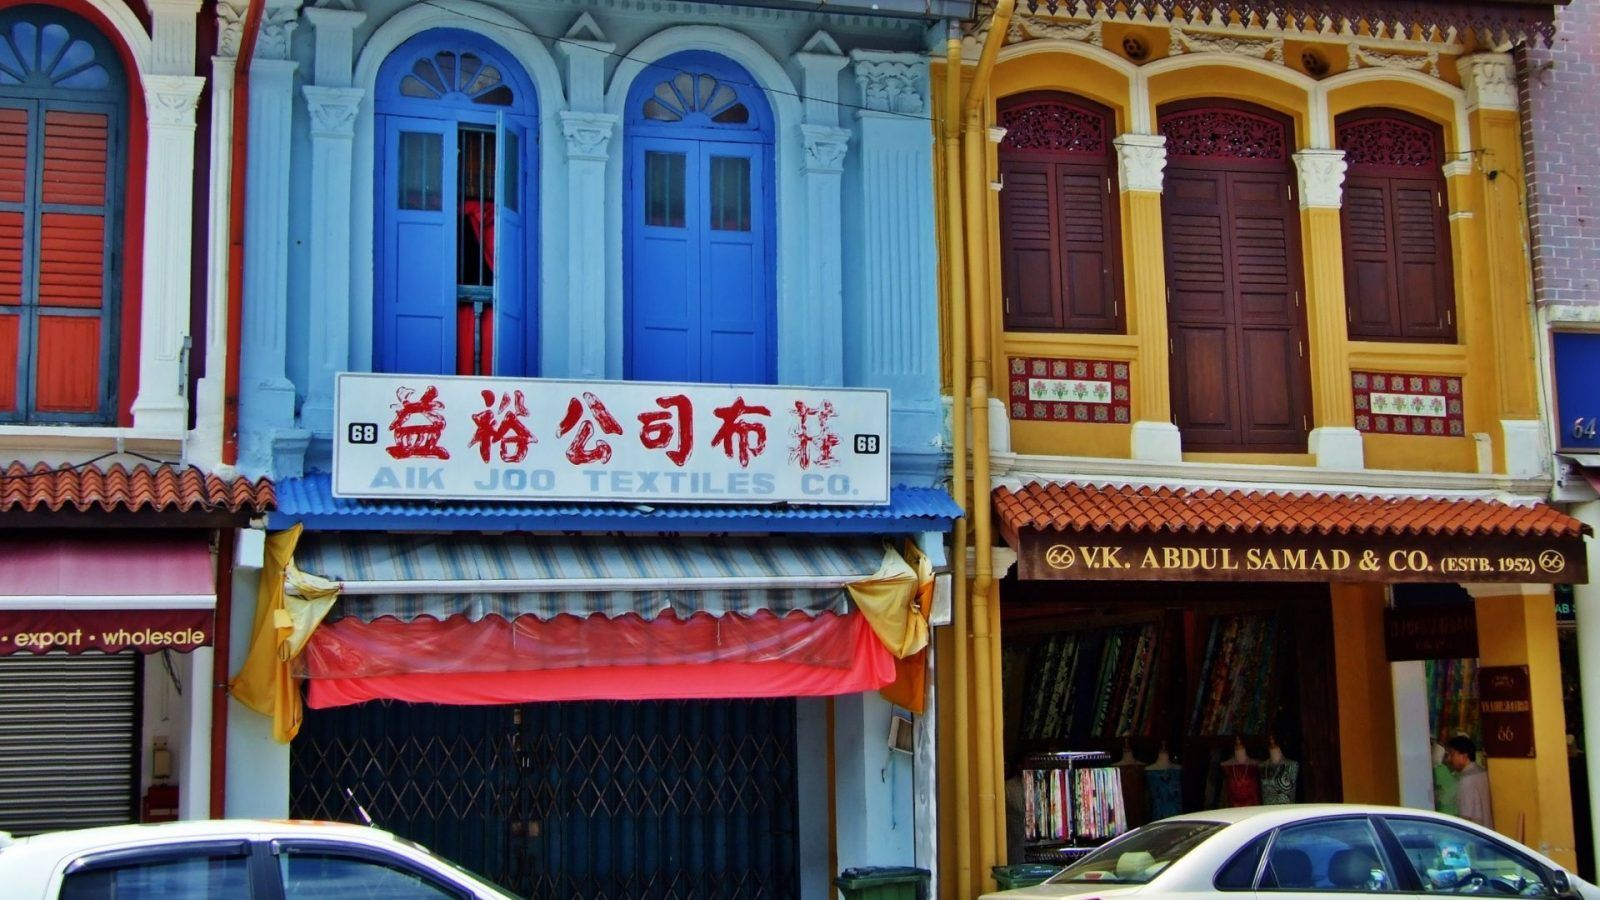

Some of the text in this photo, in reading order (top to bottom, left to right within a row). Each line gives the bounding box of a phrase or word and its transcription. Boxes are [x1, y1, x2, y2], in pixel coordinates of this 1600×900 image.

[351, 424, 376, 442] 68
[1572, 417, 1597, 439] 64
[855, 435, 878, 453] 68
[369, 466, 860, 496] AIK JOO TEXTILES CO.
[1048, 546, 1564, 575] 66 V.K. ABDUL SAMAD & CO. (ESTB. 1952) 66
[14, 628, 205, 650] export wholesale
